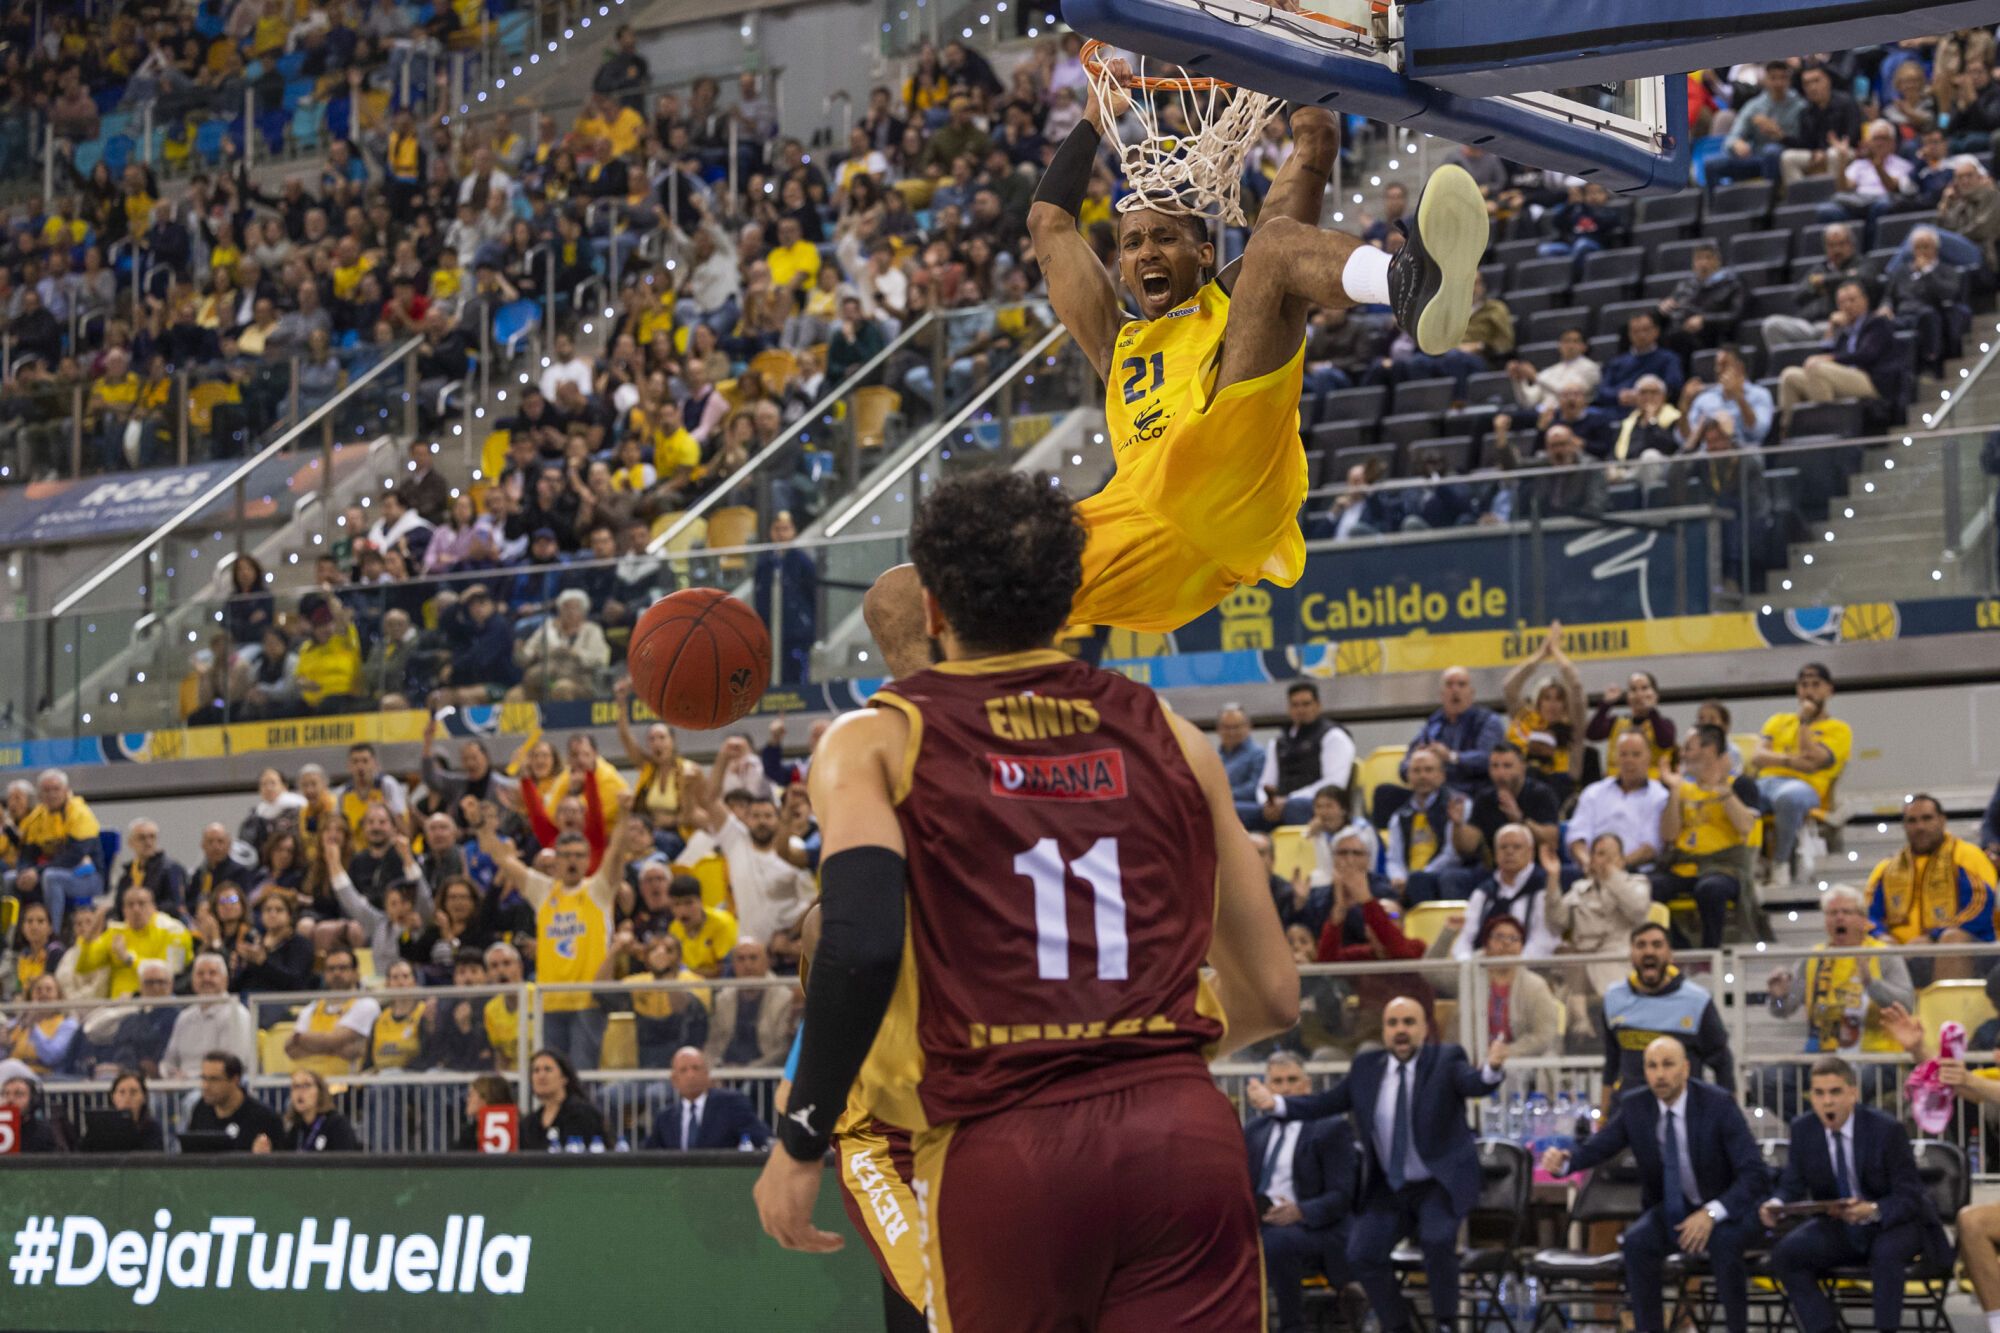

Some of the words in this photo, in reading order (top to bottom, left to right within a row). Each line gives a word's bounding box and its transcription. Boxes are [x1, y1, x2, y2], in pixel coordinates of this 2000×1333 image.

[1121, 351, 1165, 405] 21
[1301, 582, 1450, 632] Cabildo
[1456, 577, 1507, 620] de
[984, 694, 1100, 741] ENNIS
[998, 760, 1116, 790] UMANA
[1013, 837, 1129, 980] 11
[483, 1111, 511, 1152] 5
[850, 1149, 910, 1247] REYER
[9, 1208, 531, 1305] #DejaTuHuella
